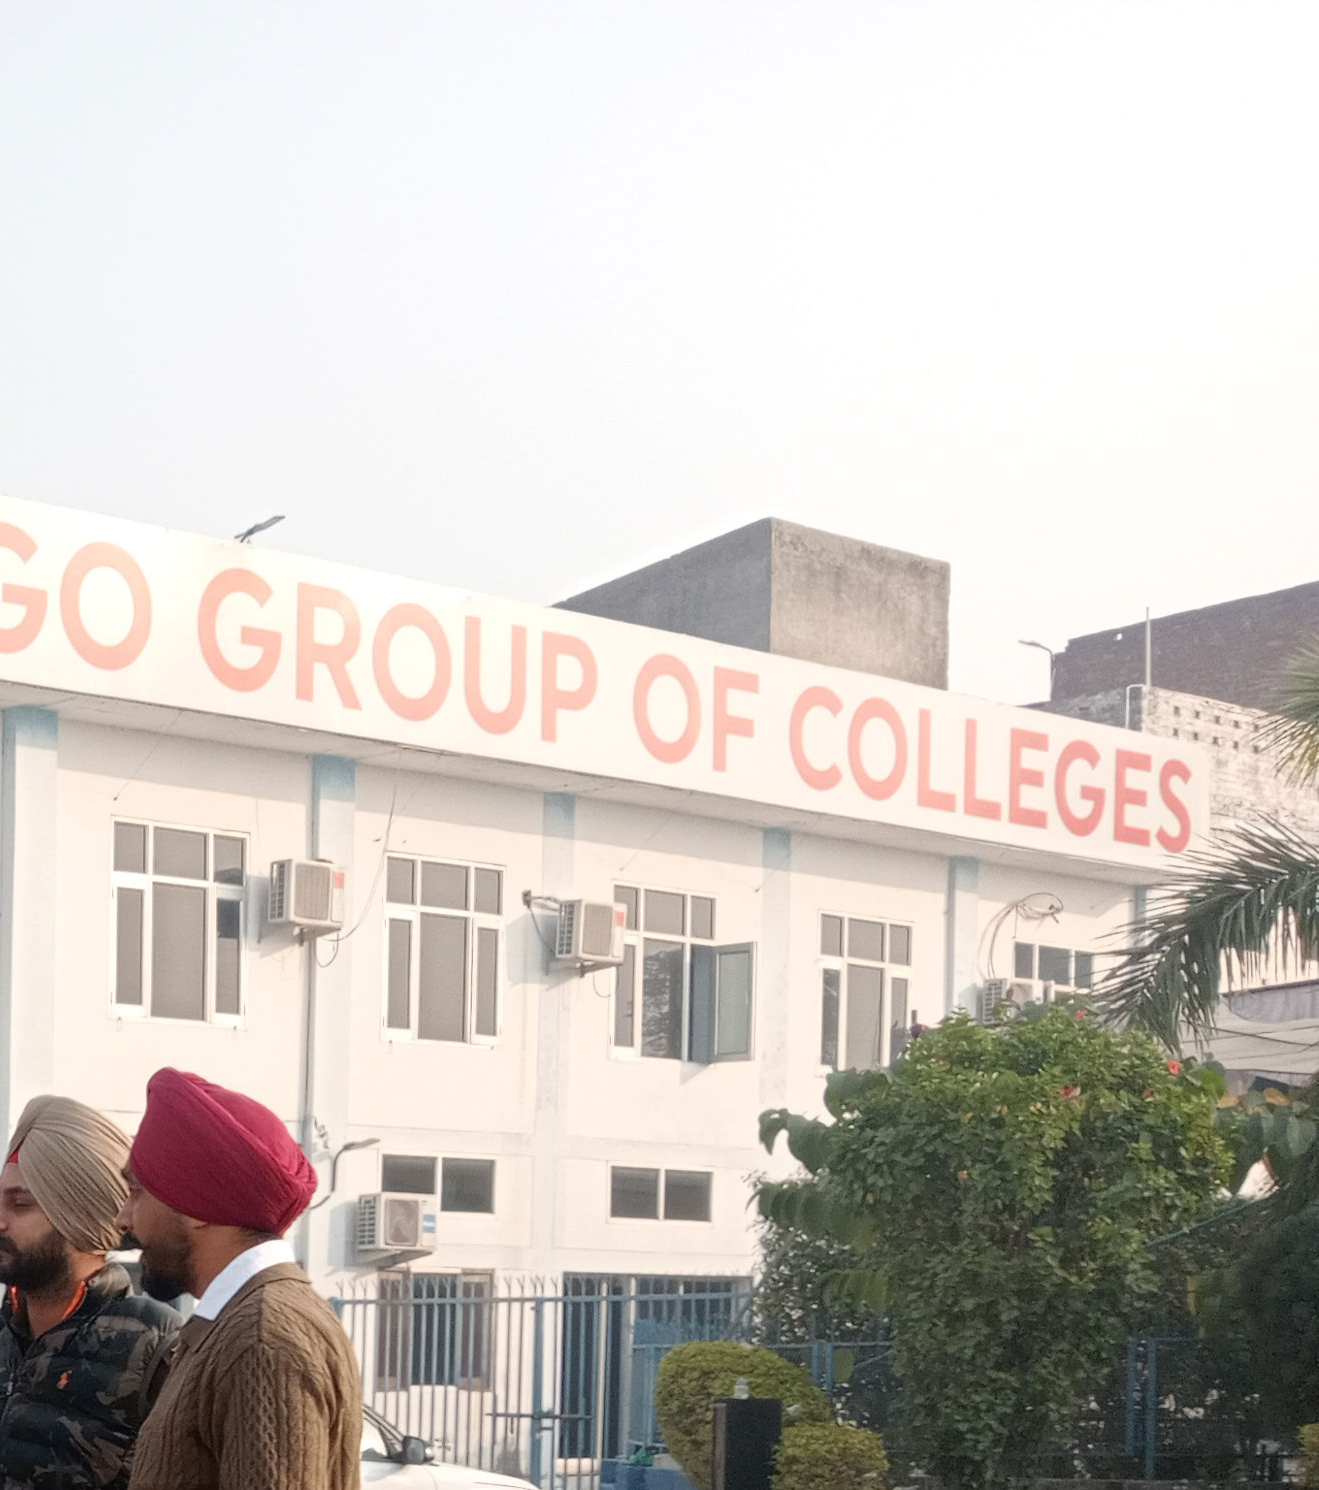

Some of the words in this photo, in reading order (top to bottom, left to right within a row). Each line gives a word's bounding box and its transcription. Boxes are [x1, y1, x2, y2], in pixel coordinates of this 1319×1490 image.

[197, 567, 599, 743] GROUP
[632, 654, 760, 772] OF
[788, 684, 1192, 854] COLLEGES
